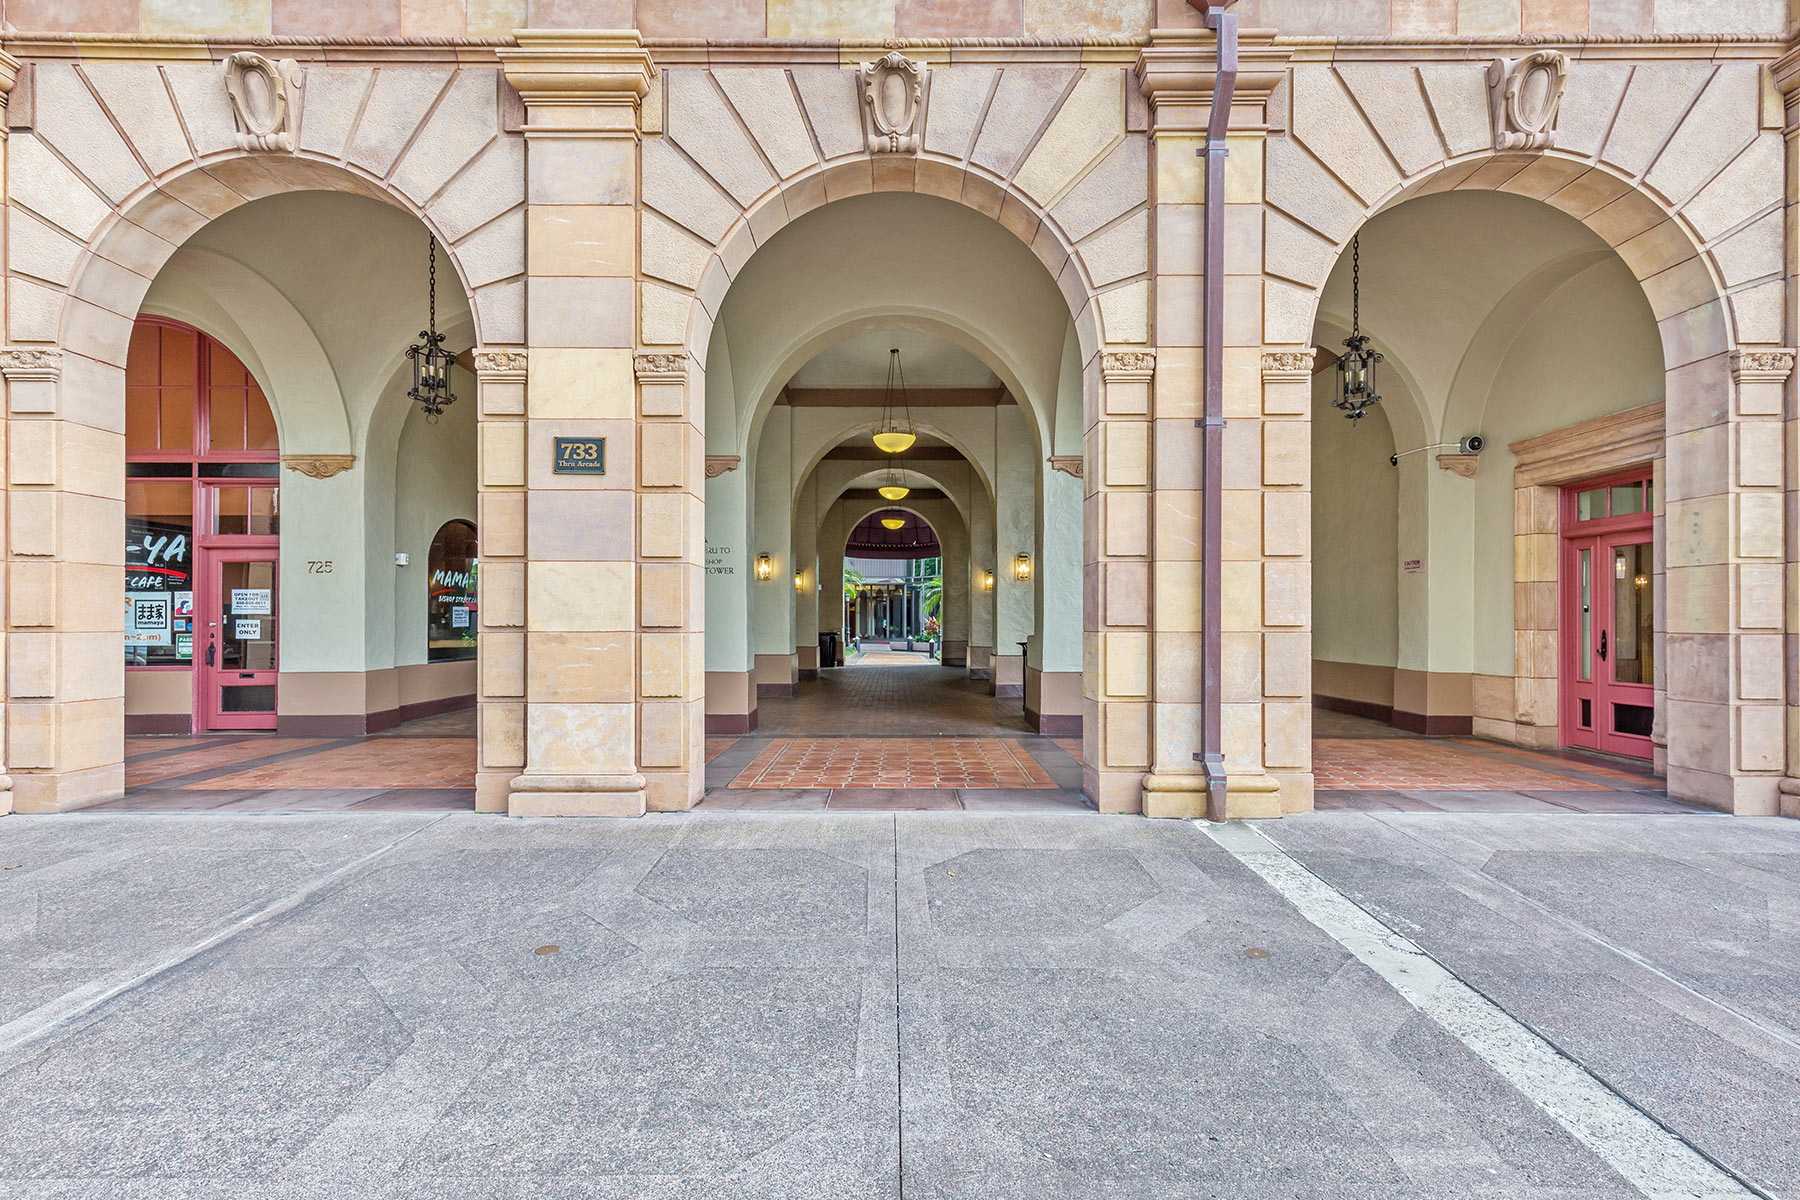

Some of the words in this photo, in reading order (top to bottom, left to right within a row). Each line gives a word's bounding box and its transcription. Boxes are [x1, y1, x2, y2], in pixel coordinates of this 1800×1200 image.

[561, 443, 598, 460] 733
[307, 560, 333, 573] 725
[131, 576, 163, 588] CAFE
[138, 604, 164, 620] まま家
